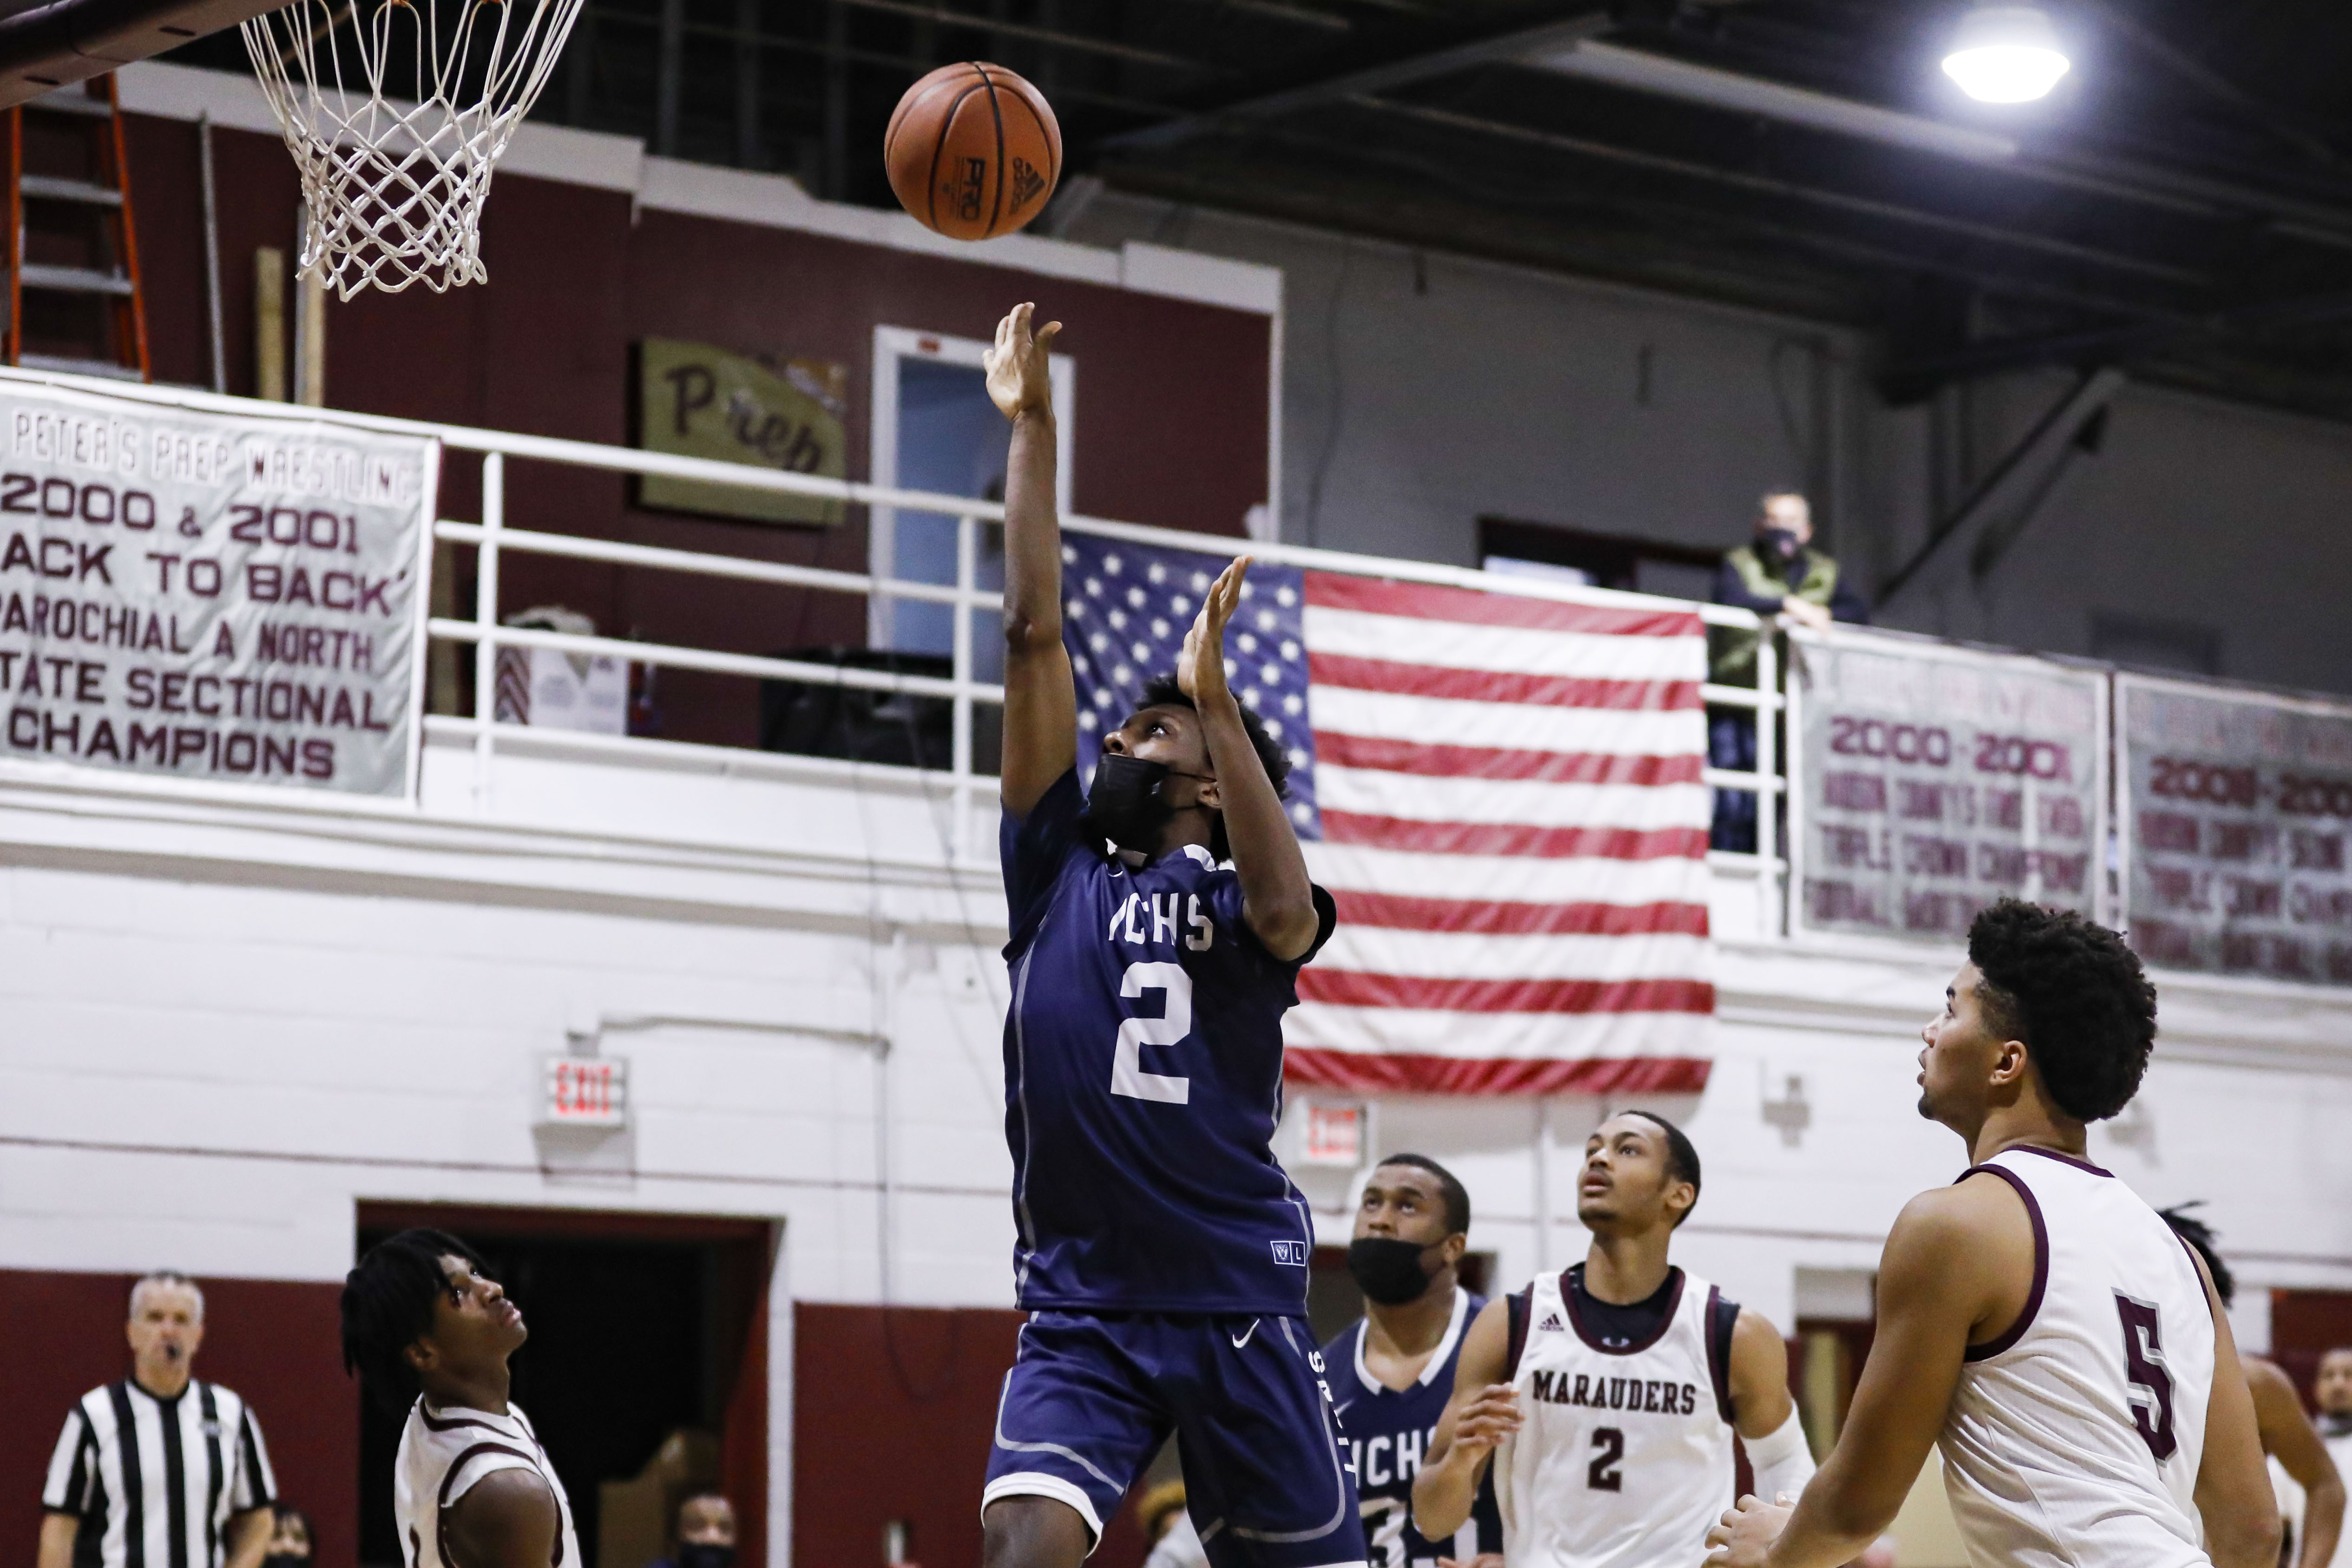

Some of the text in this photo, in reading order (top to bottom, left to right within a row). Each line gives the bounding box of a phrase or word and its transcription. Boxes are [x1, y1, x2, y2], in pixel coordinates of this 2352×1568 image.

[13, 409, 142, 476] PETER'S
[152, 429, 230, 487] PREP
[1, 473, 359, 556] 2000 & 2001
[145, 553, 223, 597] TO
[0, 590, 372, 672] AROCHIAL A NORTH
[125, 668, 389, 732] SECTIONAL
[7, 706, 335, 780] CHAMPIONS
[1830, 716, 1950, 768] 2000
[1110, 961, 1192, 1105] 2
[1296, 1247, 1301, 1260] L
[1532, 1370, 1697, 1415] MARAUDERS
[2110, 1287, 2179, 1469] 5
[1587, 1426, 1624, 1494] 2
